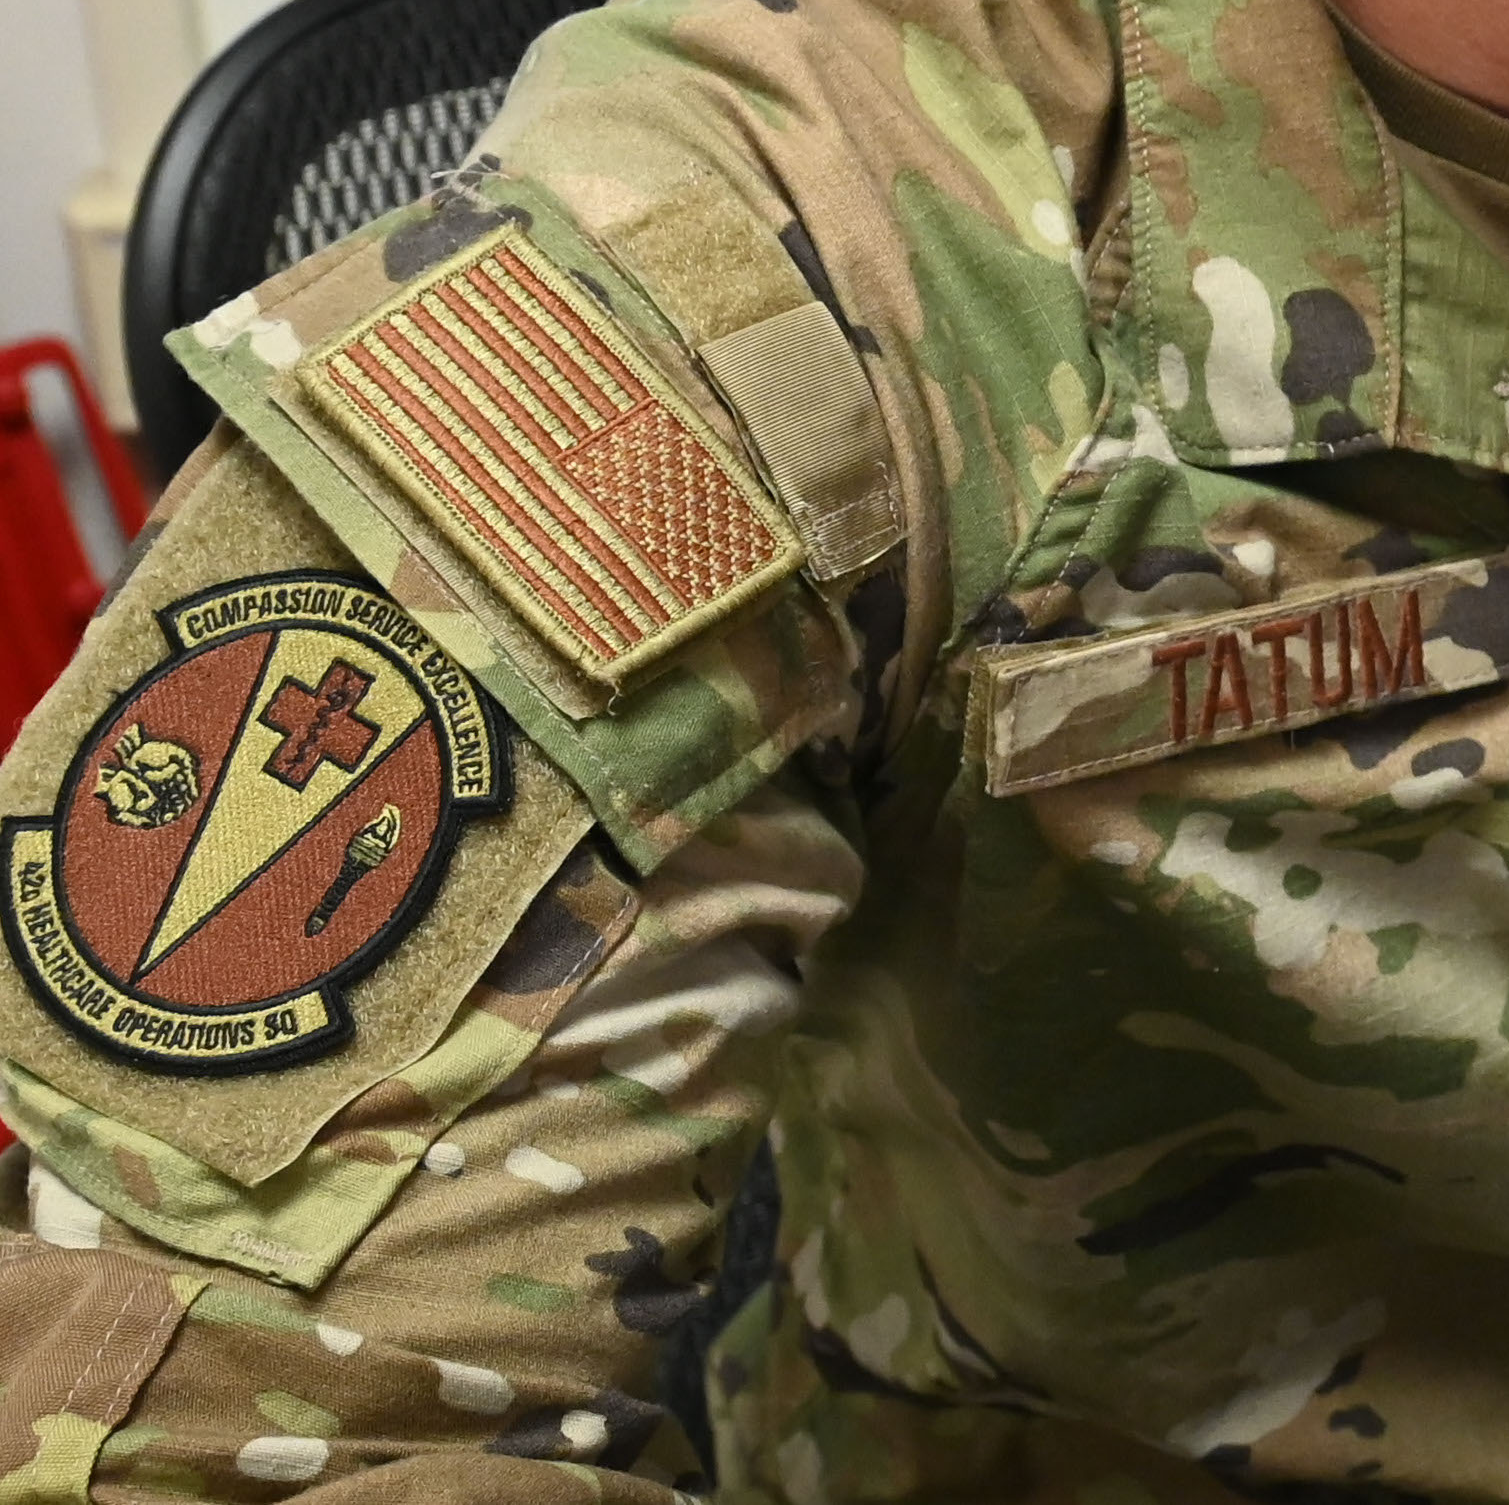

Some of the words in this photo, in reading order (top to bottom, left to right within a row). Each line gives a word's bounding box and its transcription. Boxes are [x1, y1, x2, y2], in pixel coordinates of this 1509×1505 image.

[185, 586, 346, 640] COMPASSION
[345, 593, 428, 657] SERVICE
[421, 647, 486, 796] EXCELLENCE
[1151, 588, 1426, 743] TATUM
[22, 901, 117, 1021] HEALTHCARE
[111, 1006, 256, 1052] OPERATIONS
[262, 1007, 300, 1041] SQ
